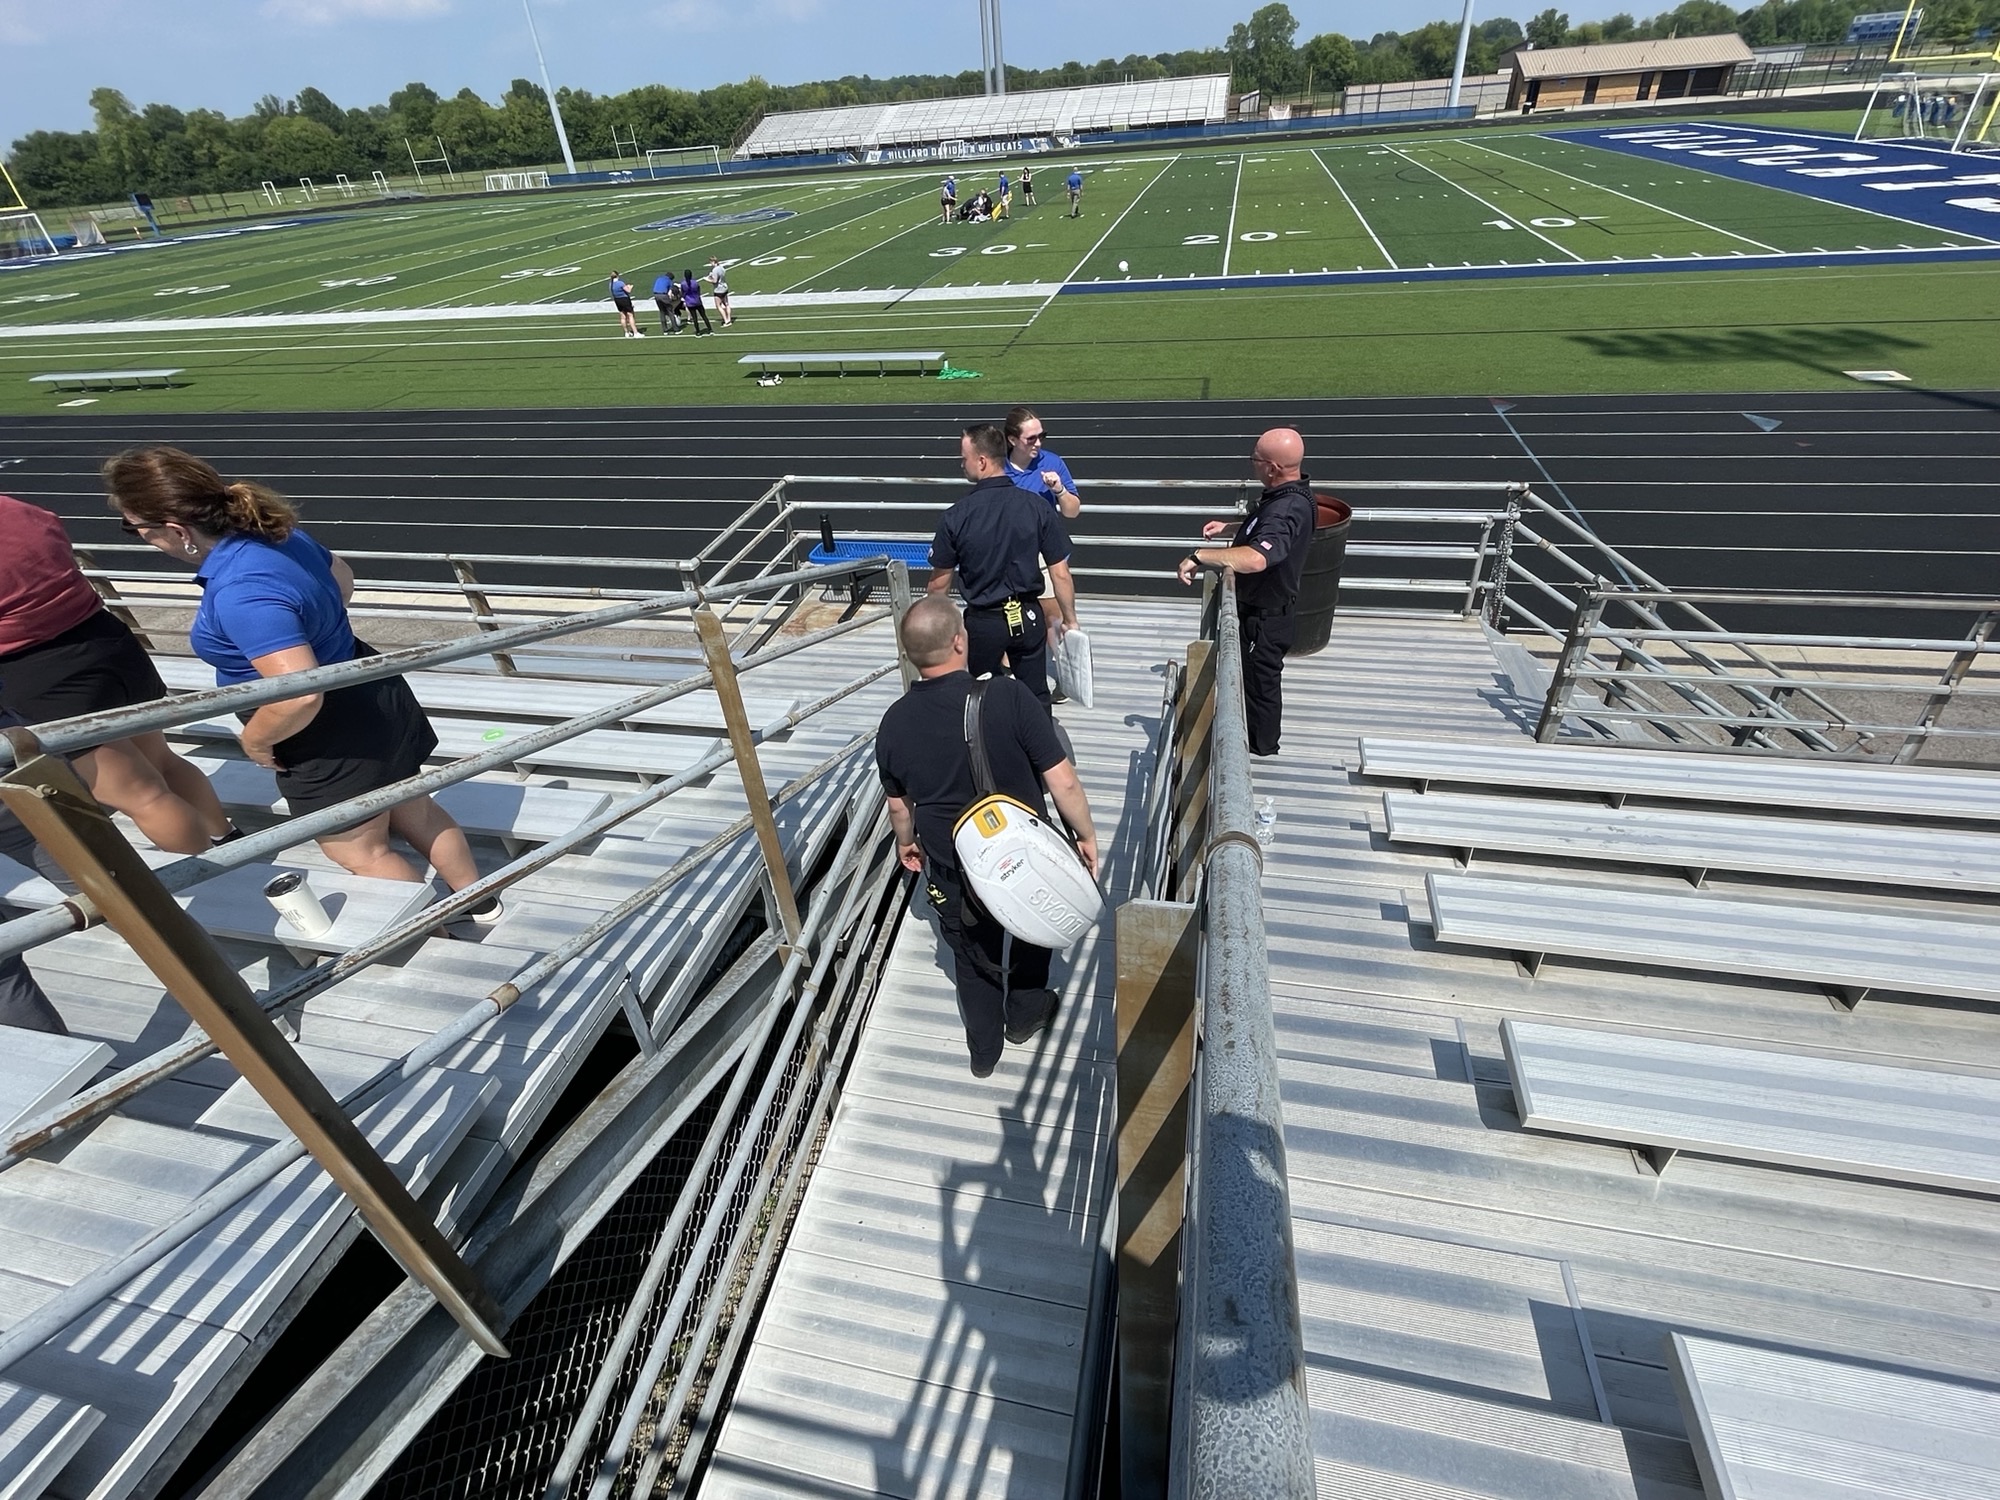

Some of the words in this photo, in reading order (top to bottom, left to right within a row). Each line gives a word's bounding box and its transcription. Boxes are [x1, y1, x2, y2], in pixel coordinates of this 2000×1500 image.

[888, 148, 928, 160] HILLIARD
[931, 144, 975, 157] DAVIDN
[978, 141, 1023, 153] WILDCATS
[1600, 130, 2000, 212] WILDCAT
[1000, 858, 1025, 882] stryker
[1029, 888, 1083, 936] LUCAS
